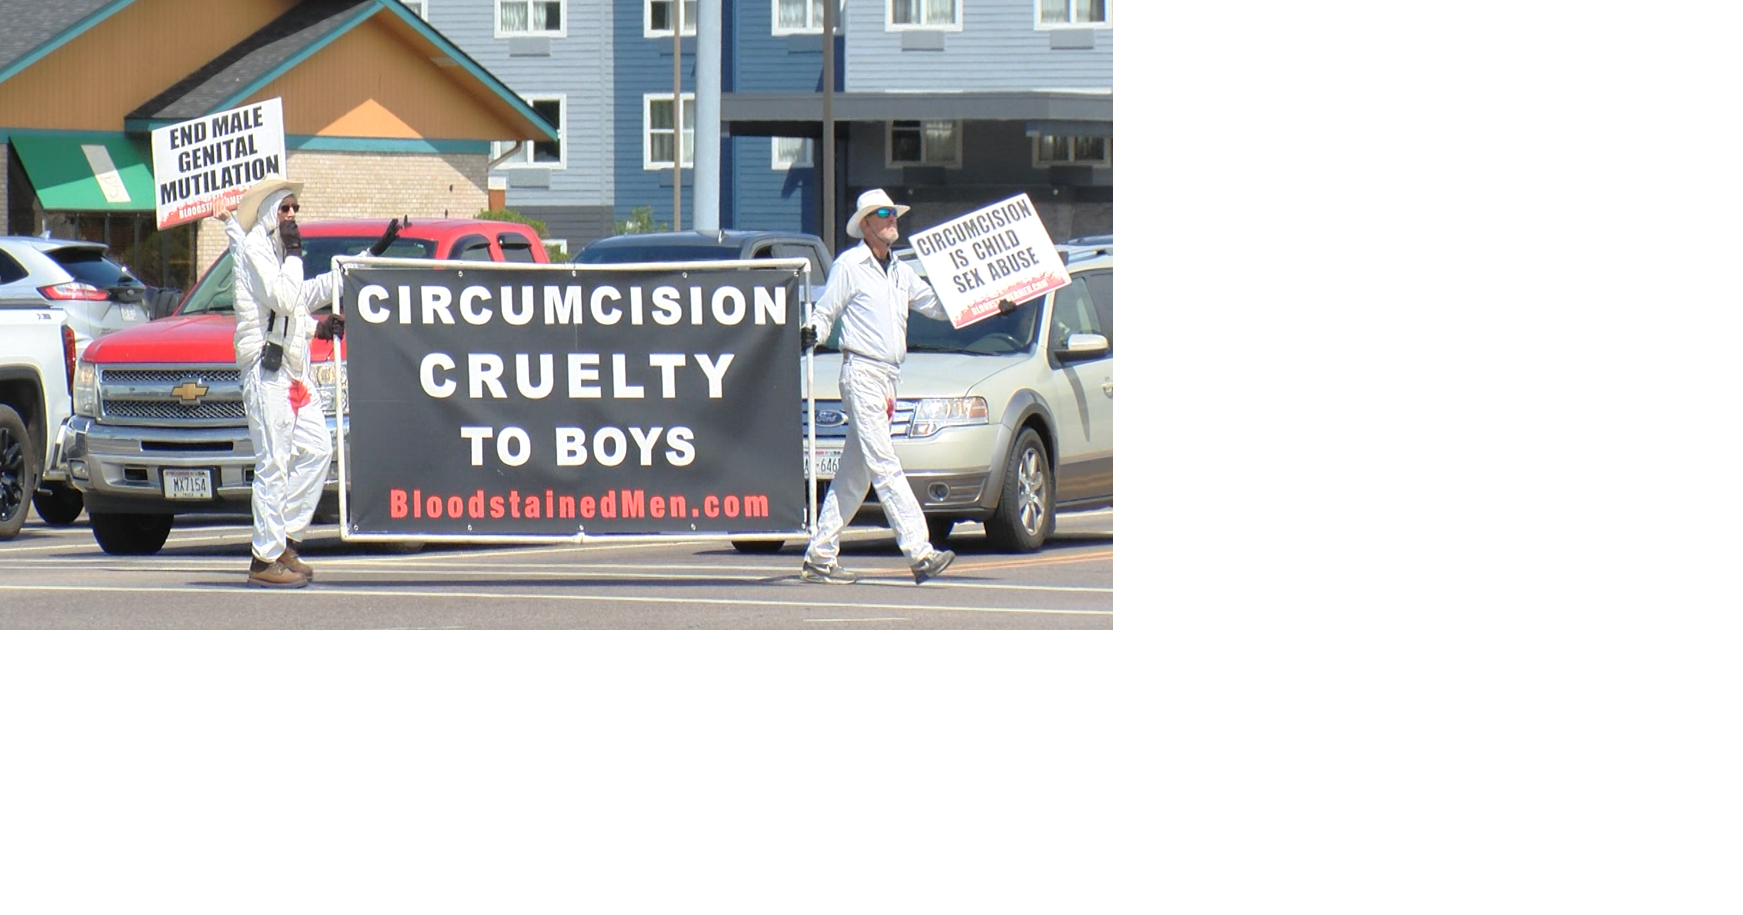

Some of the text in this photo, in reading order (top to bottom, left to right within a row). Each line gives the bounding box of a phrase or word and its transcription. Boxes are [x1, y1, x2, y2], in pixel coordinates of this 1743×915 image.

[170, 106, 263, 150] END MALE
[178, 134, 258, 173] GENITAL
[160, 154, 280, 205] MUTILATION
[916, 199, 1032, 256] CIRCUMCISION
[949, 229, 1020, 270] IS CHILD
[953, 246, 1040, 294] SEX ABUSE
[357, 284, 787, 325] CIRCUMCISION
[419, 353, 735, 399] CRUELTY
[461, 426, 696, 467] TO BOYS
[390, 489, 769, 519] BloodstainedMen.com
